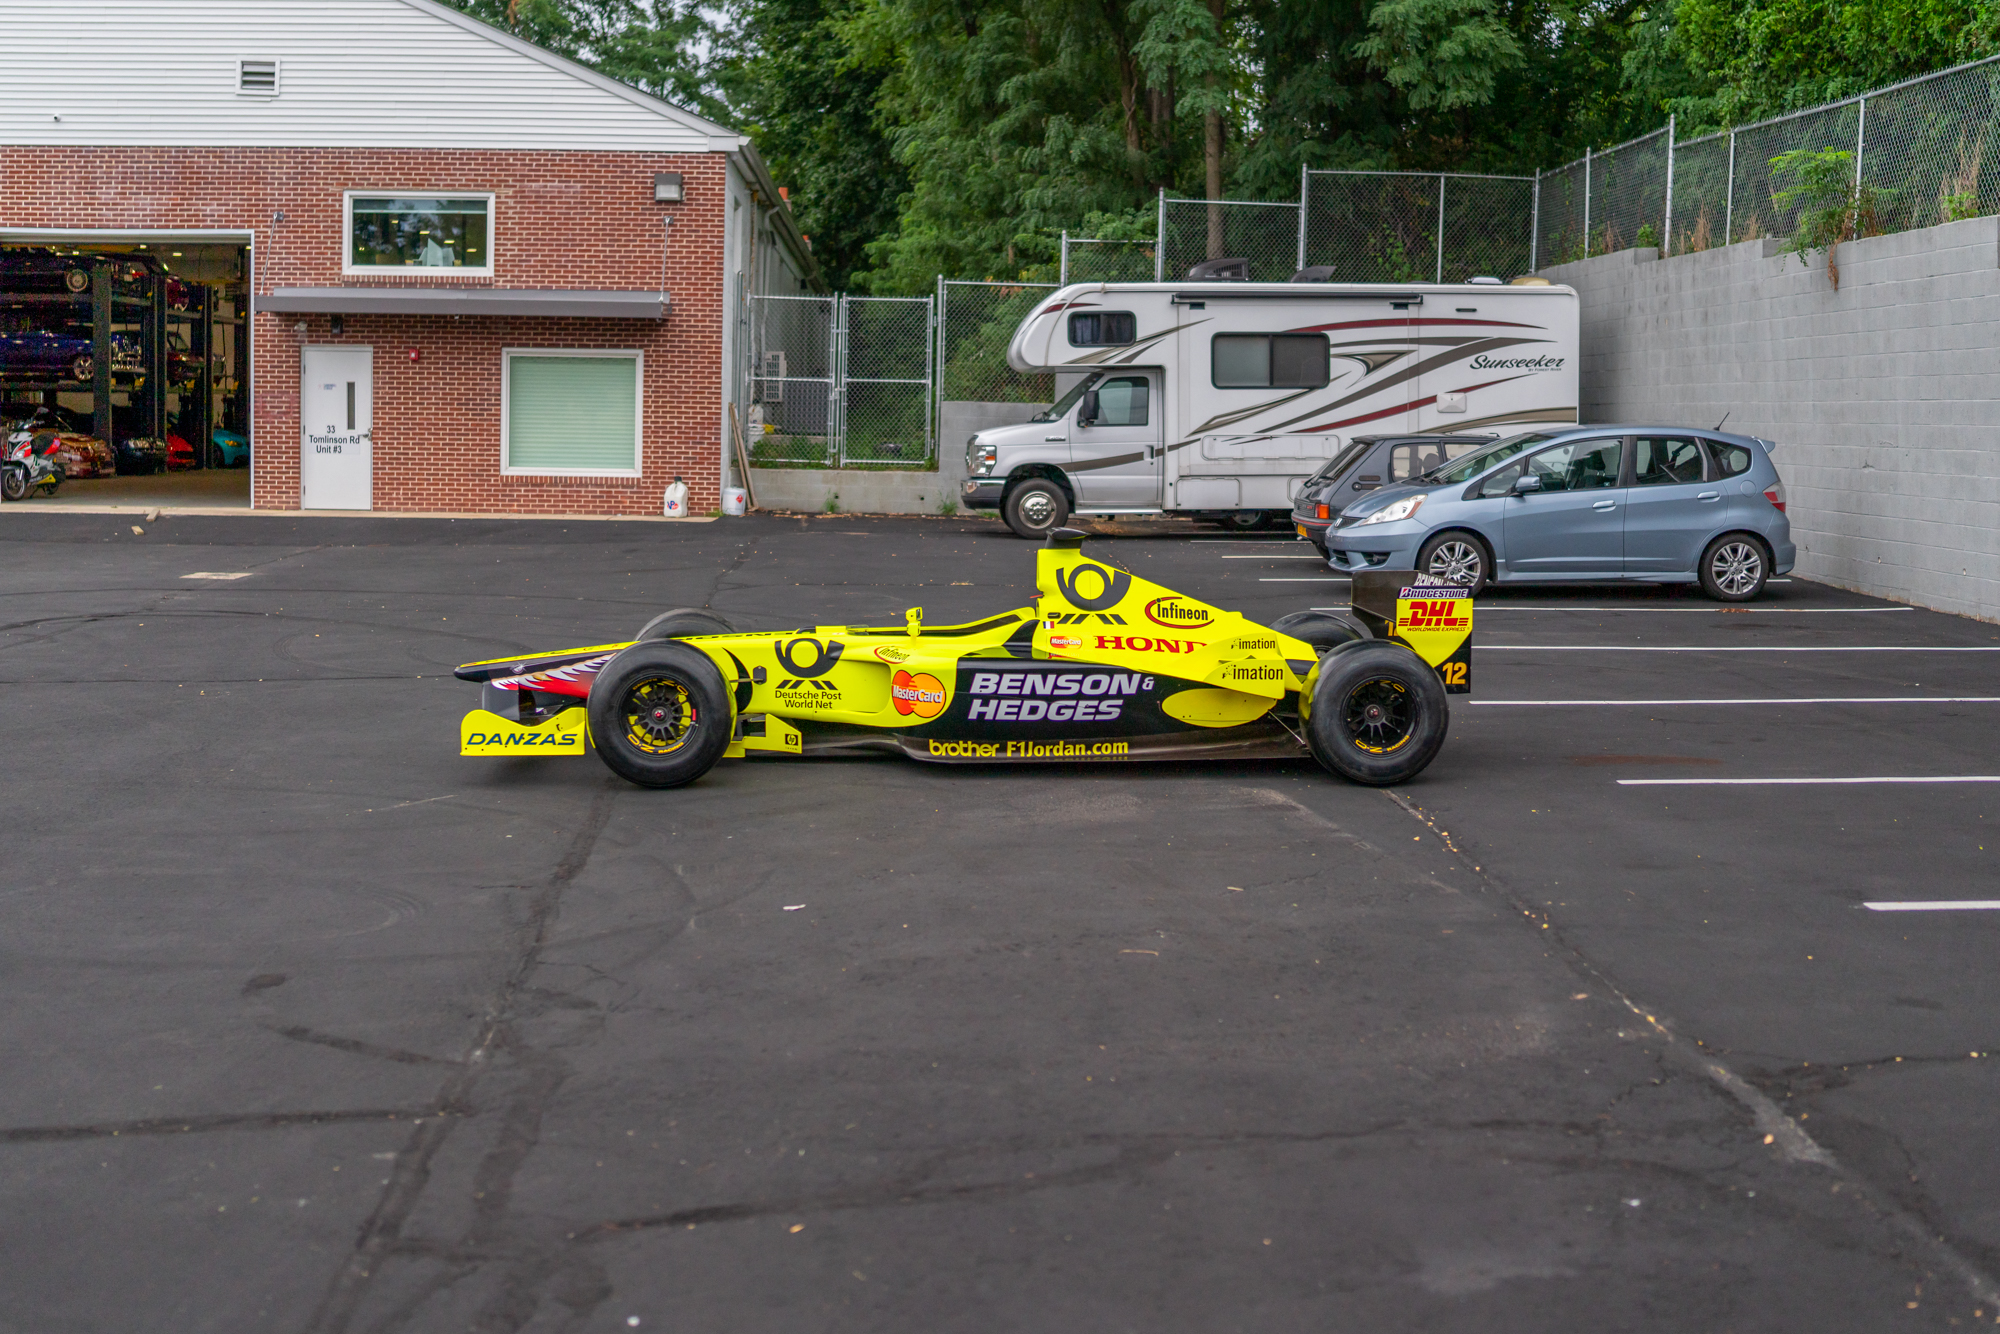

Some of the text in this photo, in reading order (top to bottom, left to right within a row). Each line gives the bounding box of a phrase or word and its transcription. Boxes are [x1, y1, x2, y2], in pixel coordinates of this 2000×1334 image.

[1469, 354, 1565, 369] Sunseeker
[326, 425, 336, 434] 33
[309, 434, 360, 444] Tomlinson Rd
[316, 444, 342, 454] Unit #3
[1399, 587, 1469, 599] BRIDGESTONE
[1409, 601, 1459, 626] DHL
[1050, 637, 1082, 645] MasterCard
[1239, 638, 1276, 650] imation
[1233, 664, 1284, 680] imation
[1442, 662, 1468, 685] 12
[969, 673, 1155, 695] BENSON &
[775, 690, 842, 700] Deutsche Post
[893, 685, 943, 703] MasterCard
[785, 699, 833, 709] World Net
[967, 699, 1124, 721] HEDGES
[466, 733, 578, 746] DANZAS
[928, 739, 1129, 757] brother F1Jordan.com
